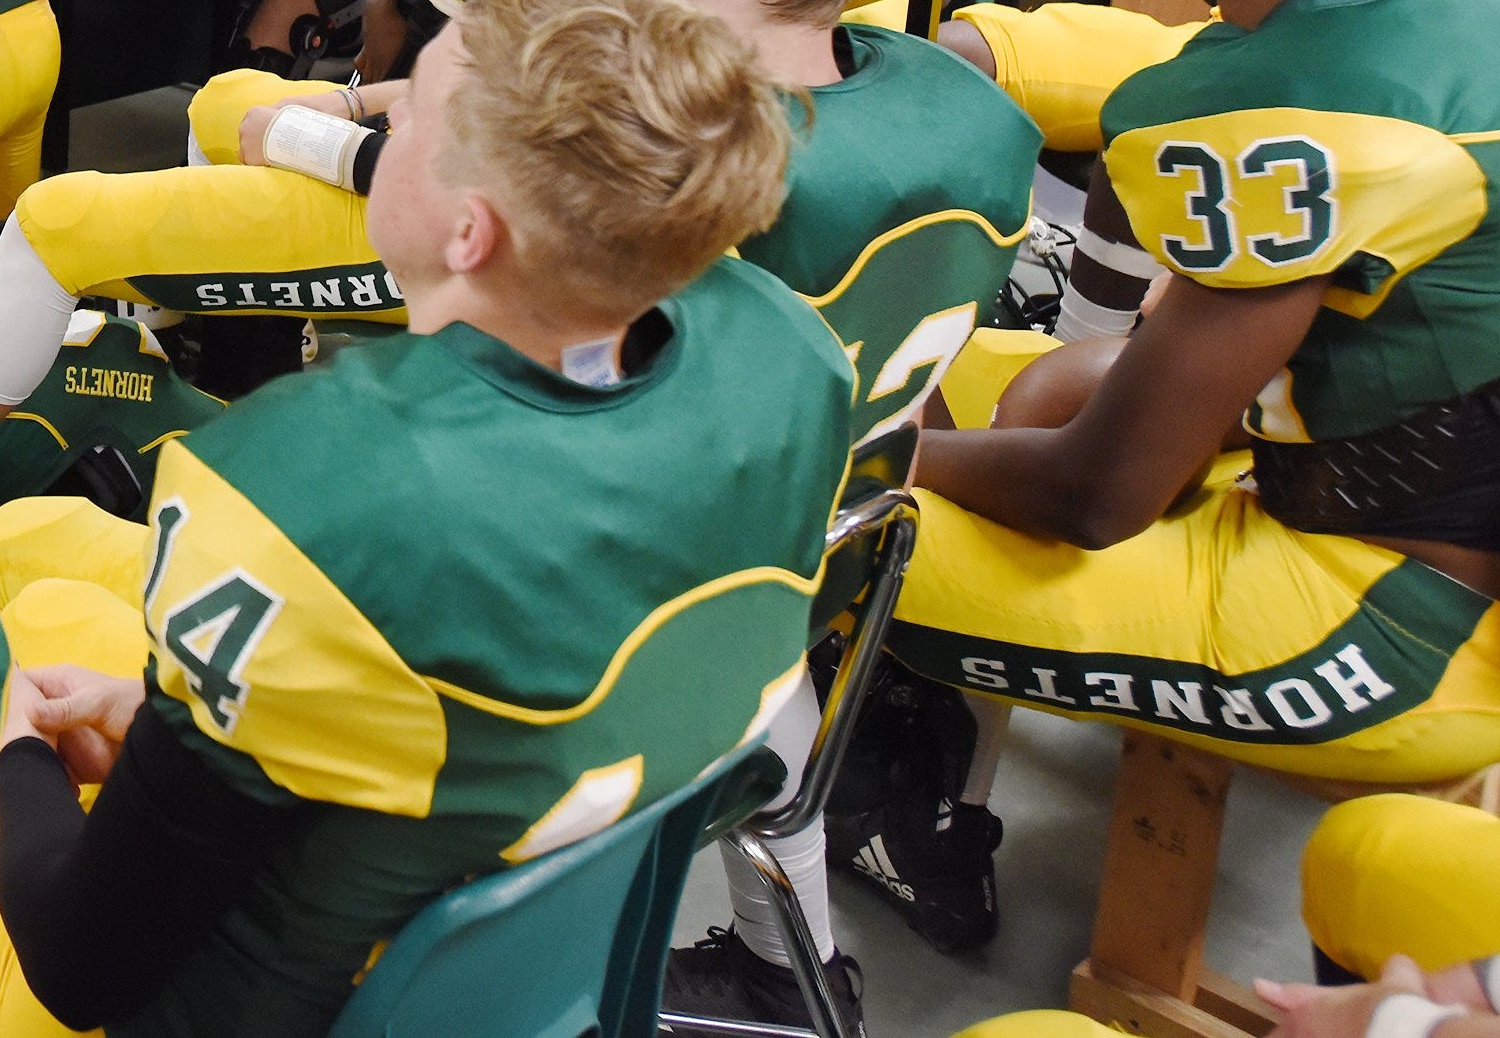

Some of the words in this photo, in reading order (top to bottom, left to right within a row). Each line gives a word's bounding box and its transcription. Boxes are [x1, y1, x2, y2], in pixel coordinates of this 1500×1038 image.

[1154, 134, 1337, 272] 33
[65, 366, 154, 402] HORNETS
[960, 643, 1398, 733] HORNETS
